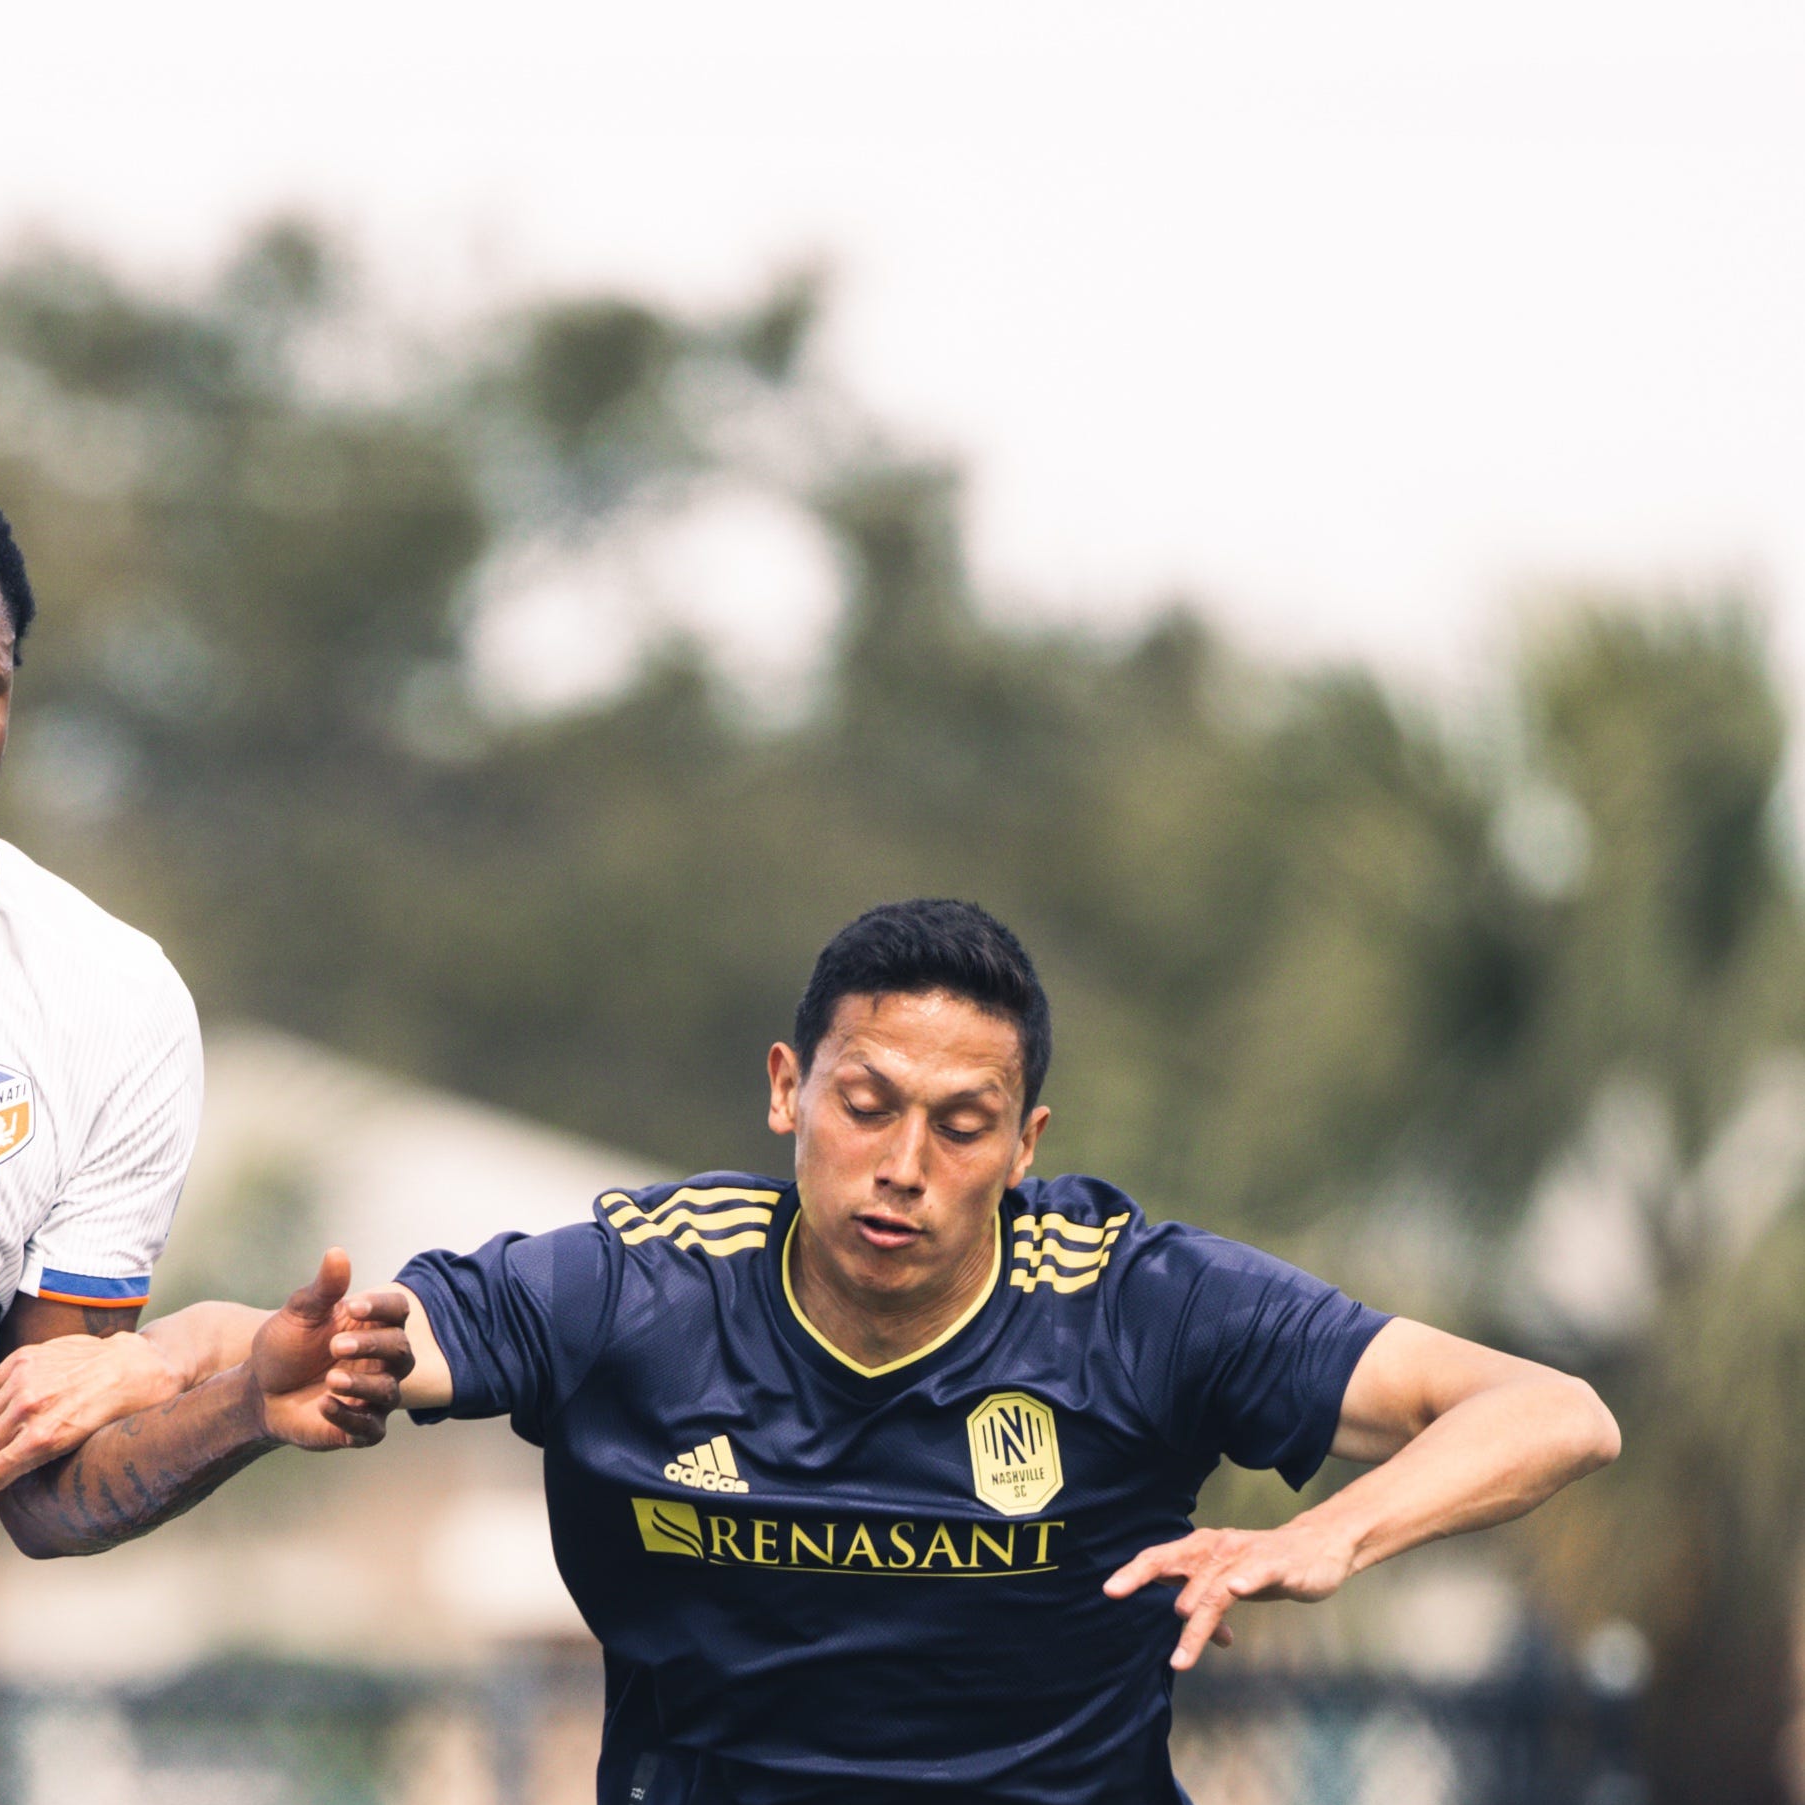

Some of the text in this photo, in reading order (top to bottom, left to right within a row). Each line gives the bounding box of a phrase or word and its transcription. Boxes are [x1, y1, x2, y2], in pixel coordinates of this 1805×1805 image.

[664, 1462, 750, 1494] adidas
[991, 1467, 1046, 1486] NASHVILLE
[1013, 1485, 1027, 1498] SC
[708, 1517, 1065, 1569] RENASANT
